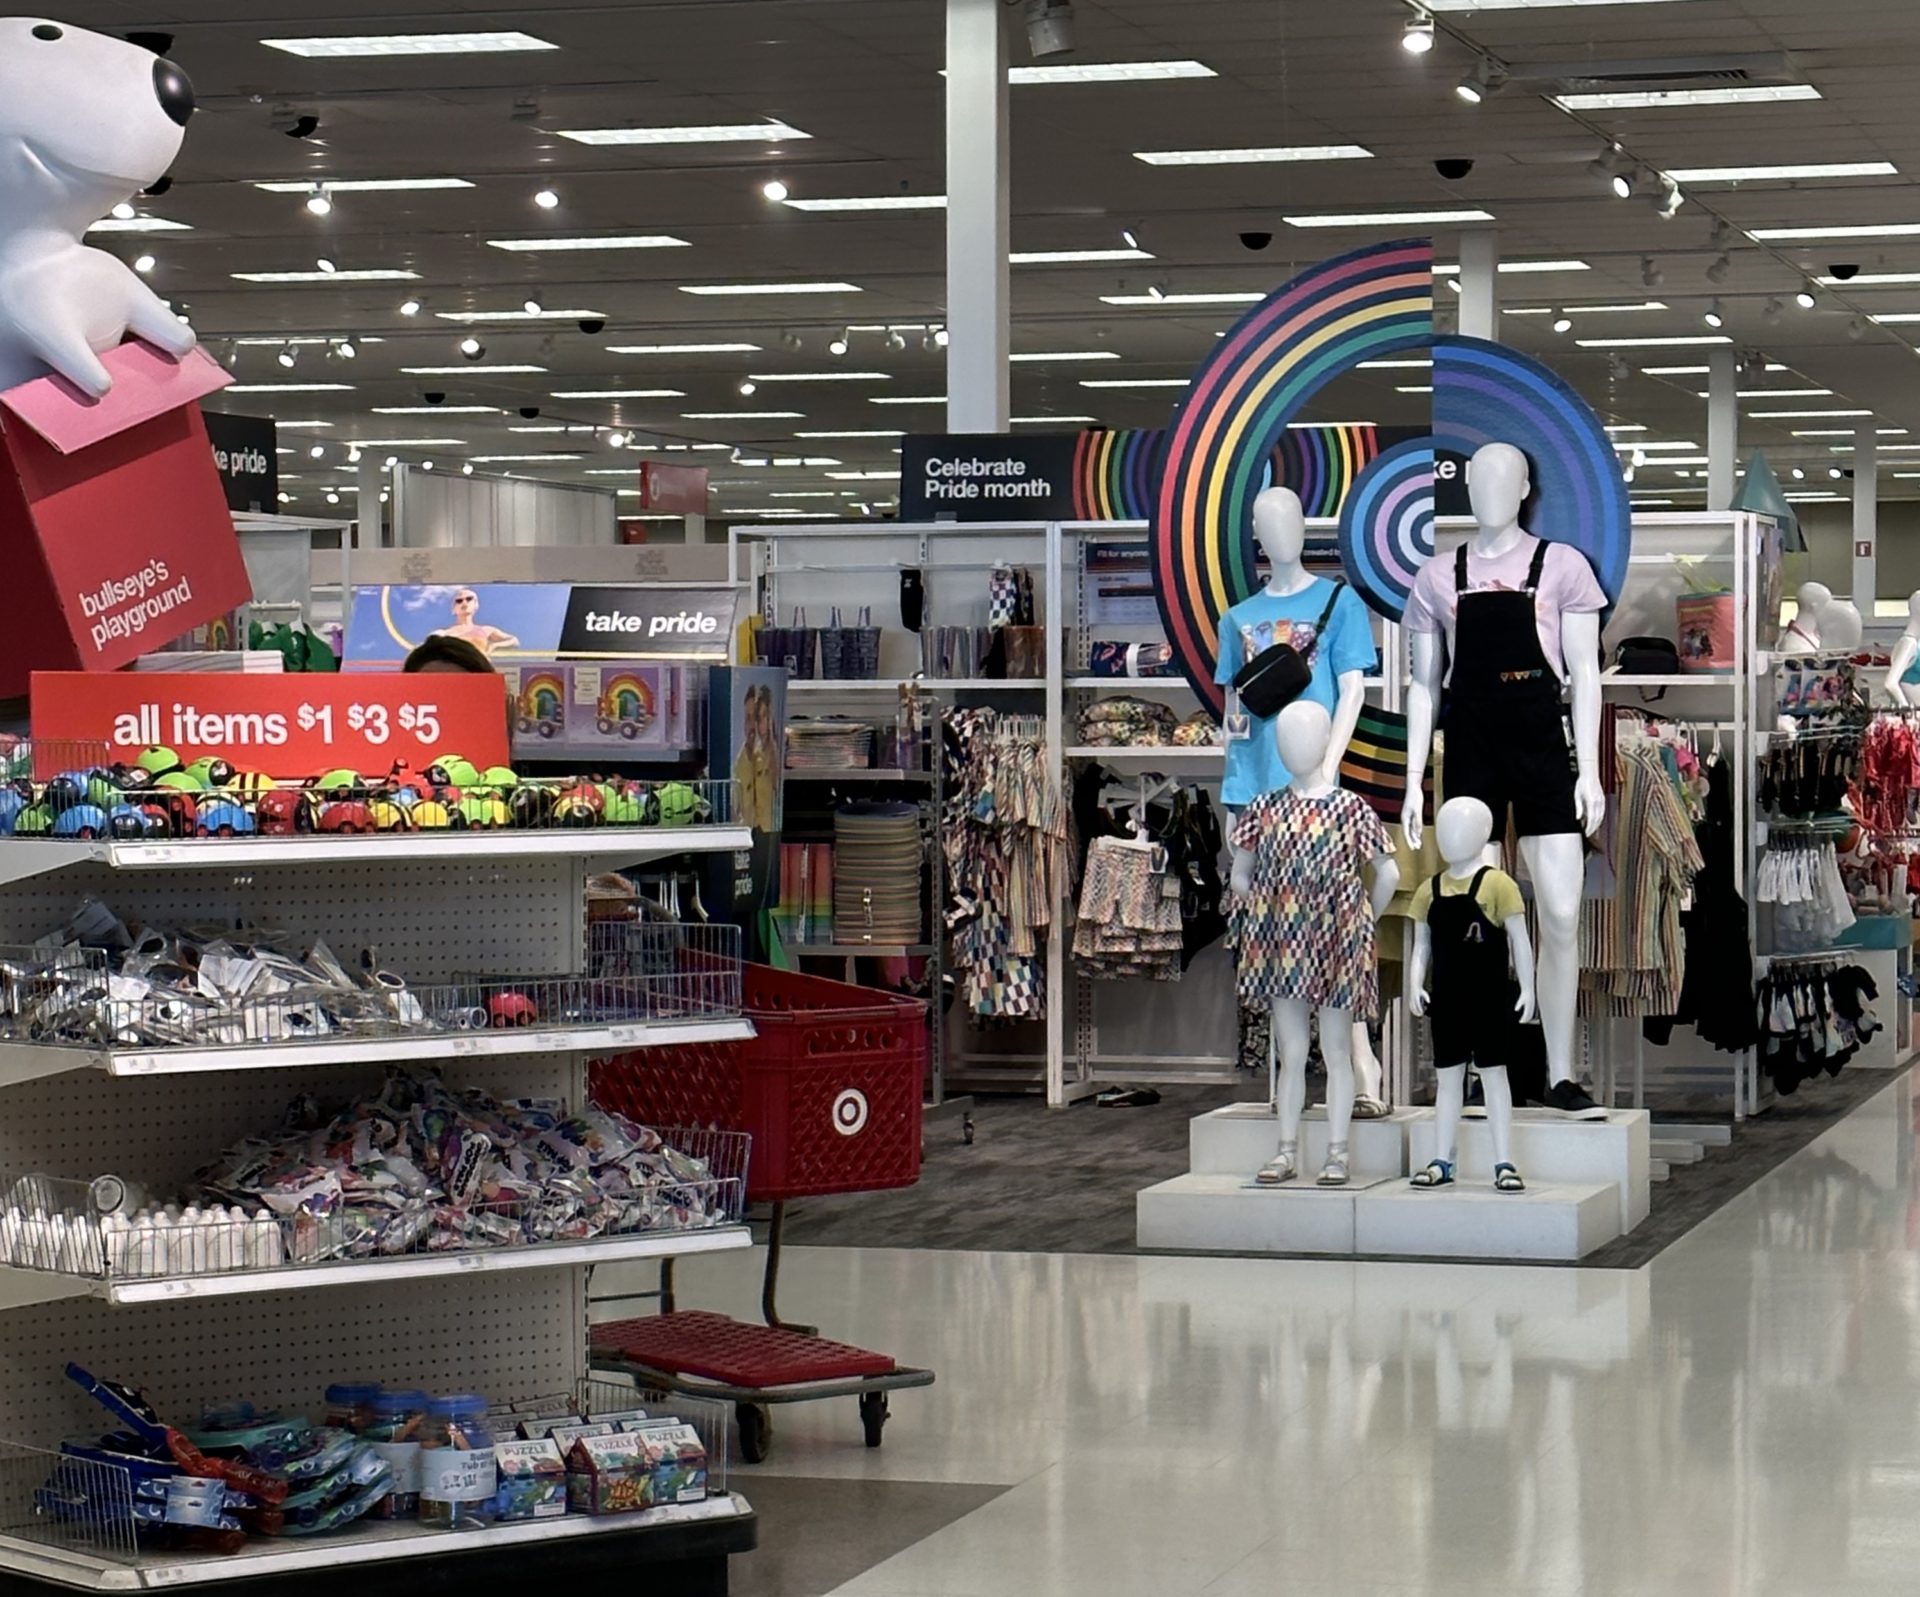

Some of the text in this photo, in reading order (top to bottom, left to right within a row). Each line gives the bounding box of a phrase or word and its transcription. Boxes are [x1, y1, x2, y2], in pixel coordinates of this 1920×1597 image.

[231, 446, 267, 477] pride
[925, 457, 1026, 477] Celebrate
[925, 478, 1051, 498] Pride month
[91, 576, 192, 652] playground
[585, 610, 717, 637] take pride
[113, 702, 440, 746] all items $1 $3 $5
[594, 1438, 633, 1451] PUZZLE
[648, 1430, 687, 1443] PUZZLE
[504, 1443, 547, 1456] PUZZLE
